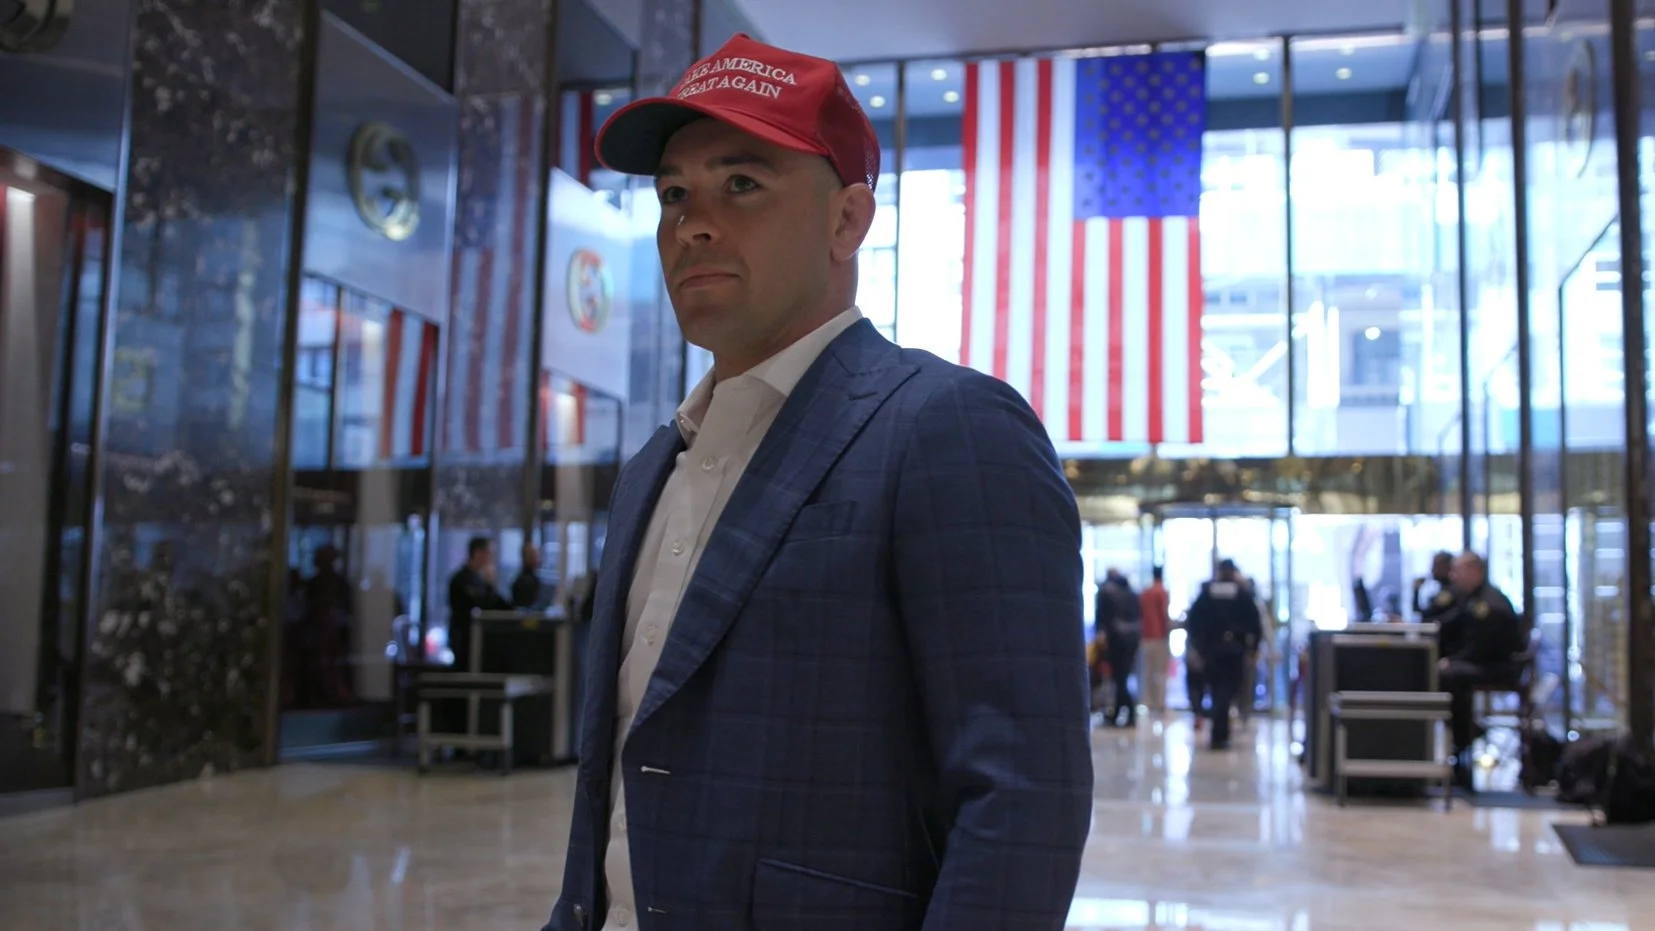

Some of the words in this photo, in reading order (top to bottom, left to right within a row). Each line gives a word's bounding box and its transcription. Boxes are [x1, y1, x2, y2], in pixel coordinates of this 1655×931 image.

[709, 57, 797, 85] AMERICA
[677, 77, 719, 100] REAT
[717, 75, 782, 99] AGAIN
